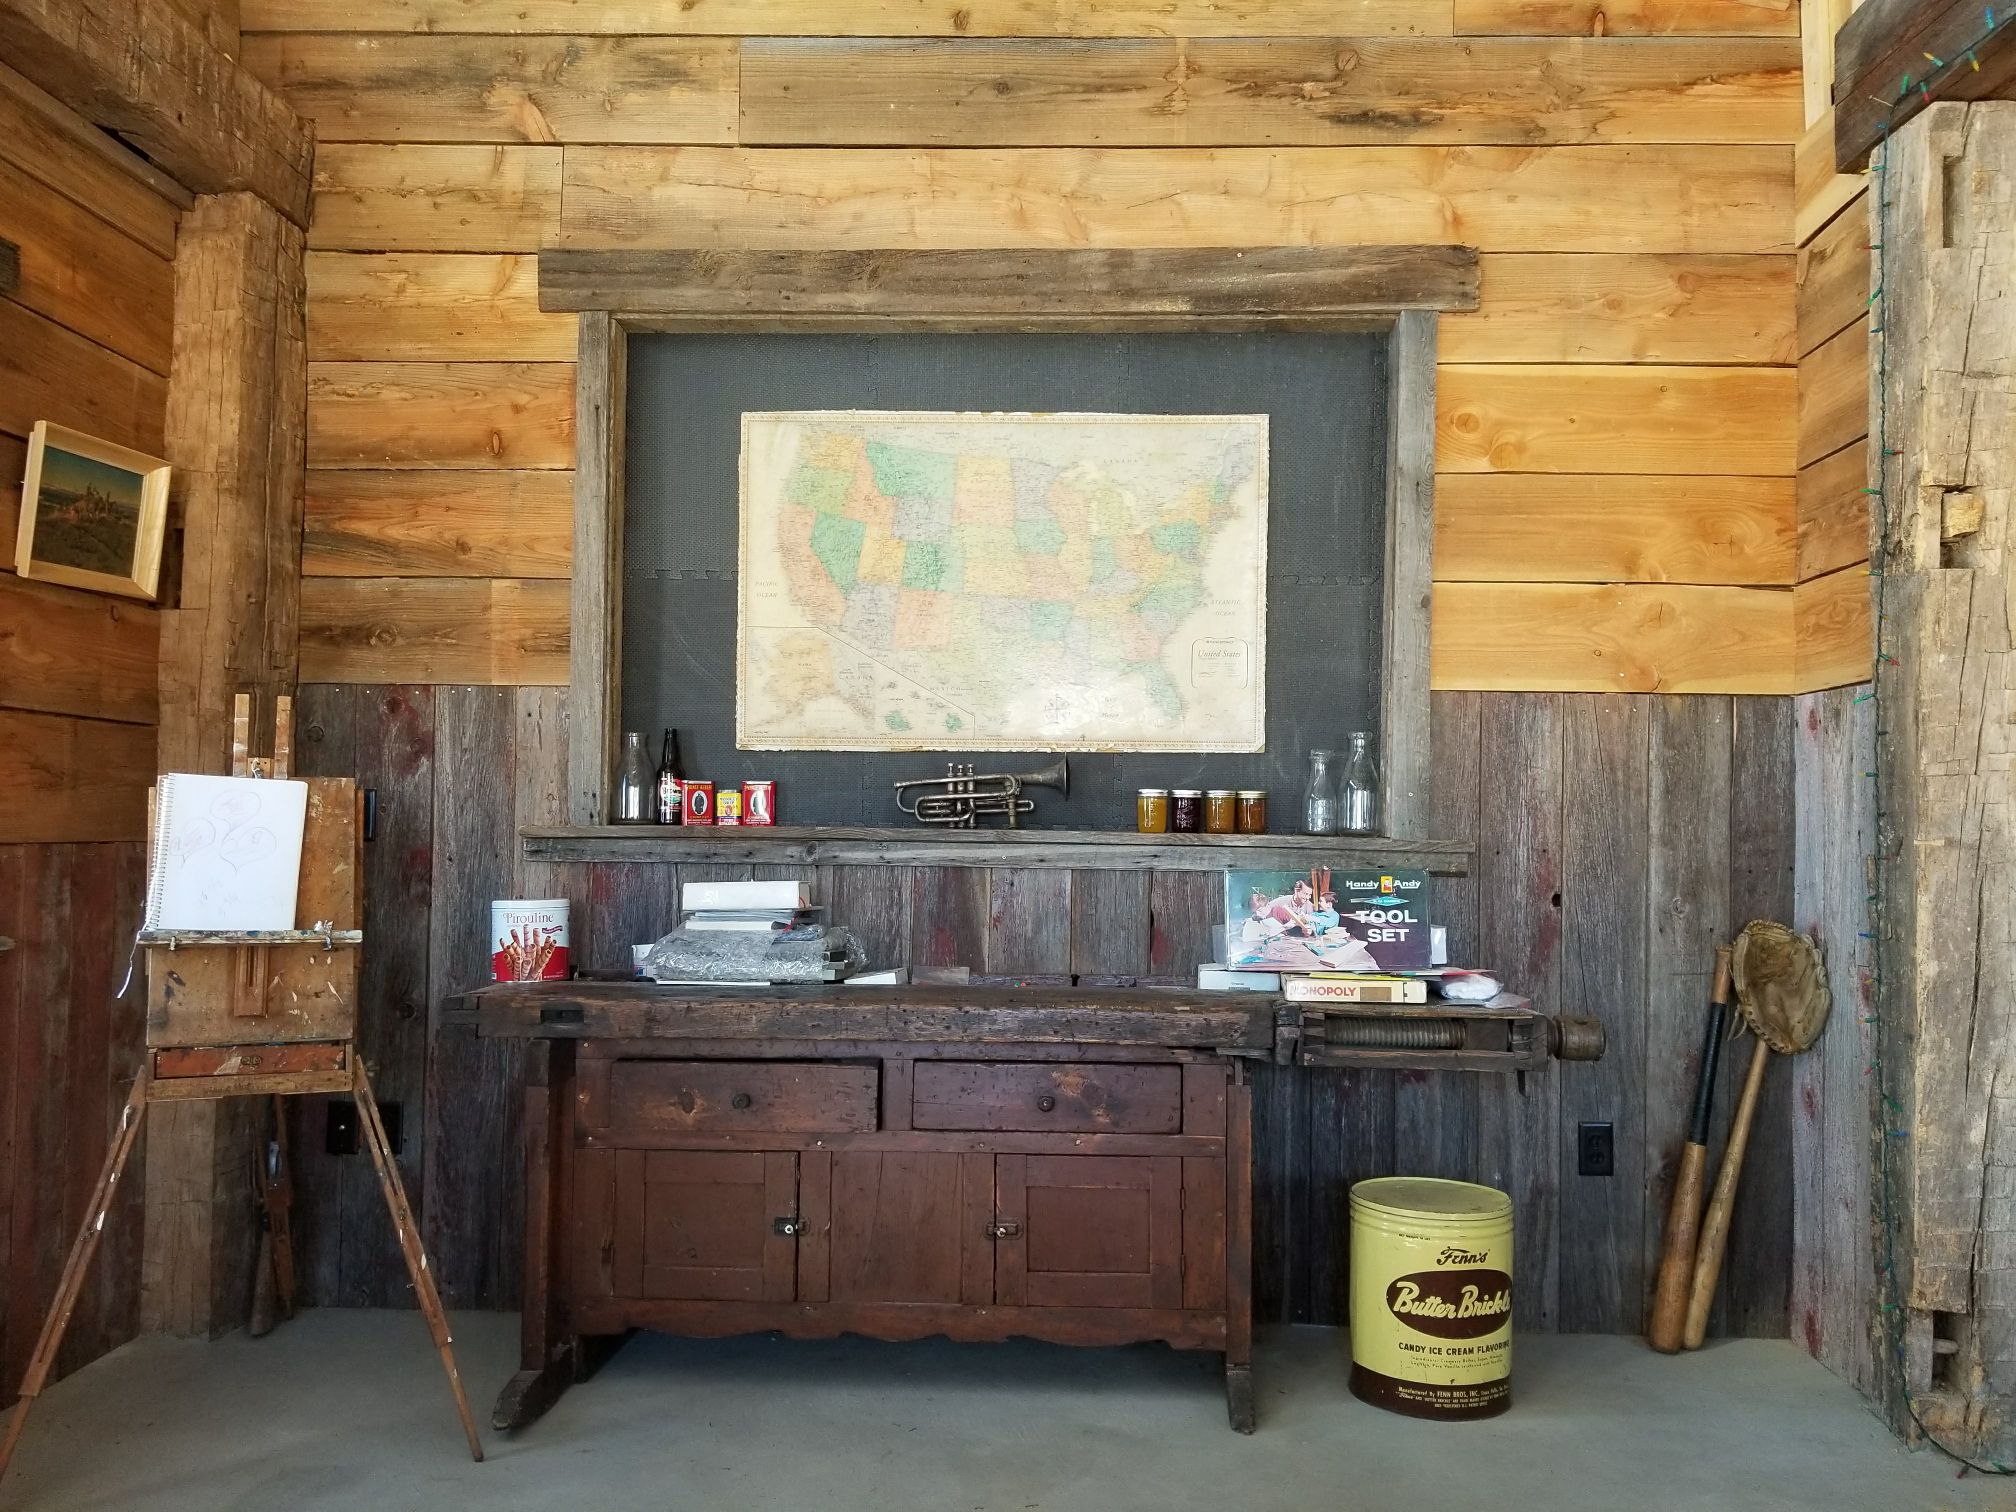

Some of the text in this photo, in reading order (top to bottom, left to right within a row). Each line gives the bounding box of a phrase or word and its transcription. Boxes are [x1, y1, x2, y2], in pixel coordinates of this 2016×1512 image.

[1198, 650, 1241, 658] United States
[1345, 880, 1422, 890] Handy Andy
[503, 912, 554, 924] Pirouline
[1355, 909, 1418, 924] TOOL
[1367, 928, 1410, 942] SET
[1436, 1246, 1489, 1266] Fenn's
[1392, 1281, 1457, 1319] Butter
[1398, 1342, 1427, 1354] CANDY
[1429, 1347, 1443, 1356] ICE
[1446, 1346, 1475, 1356] CREAM
